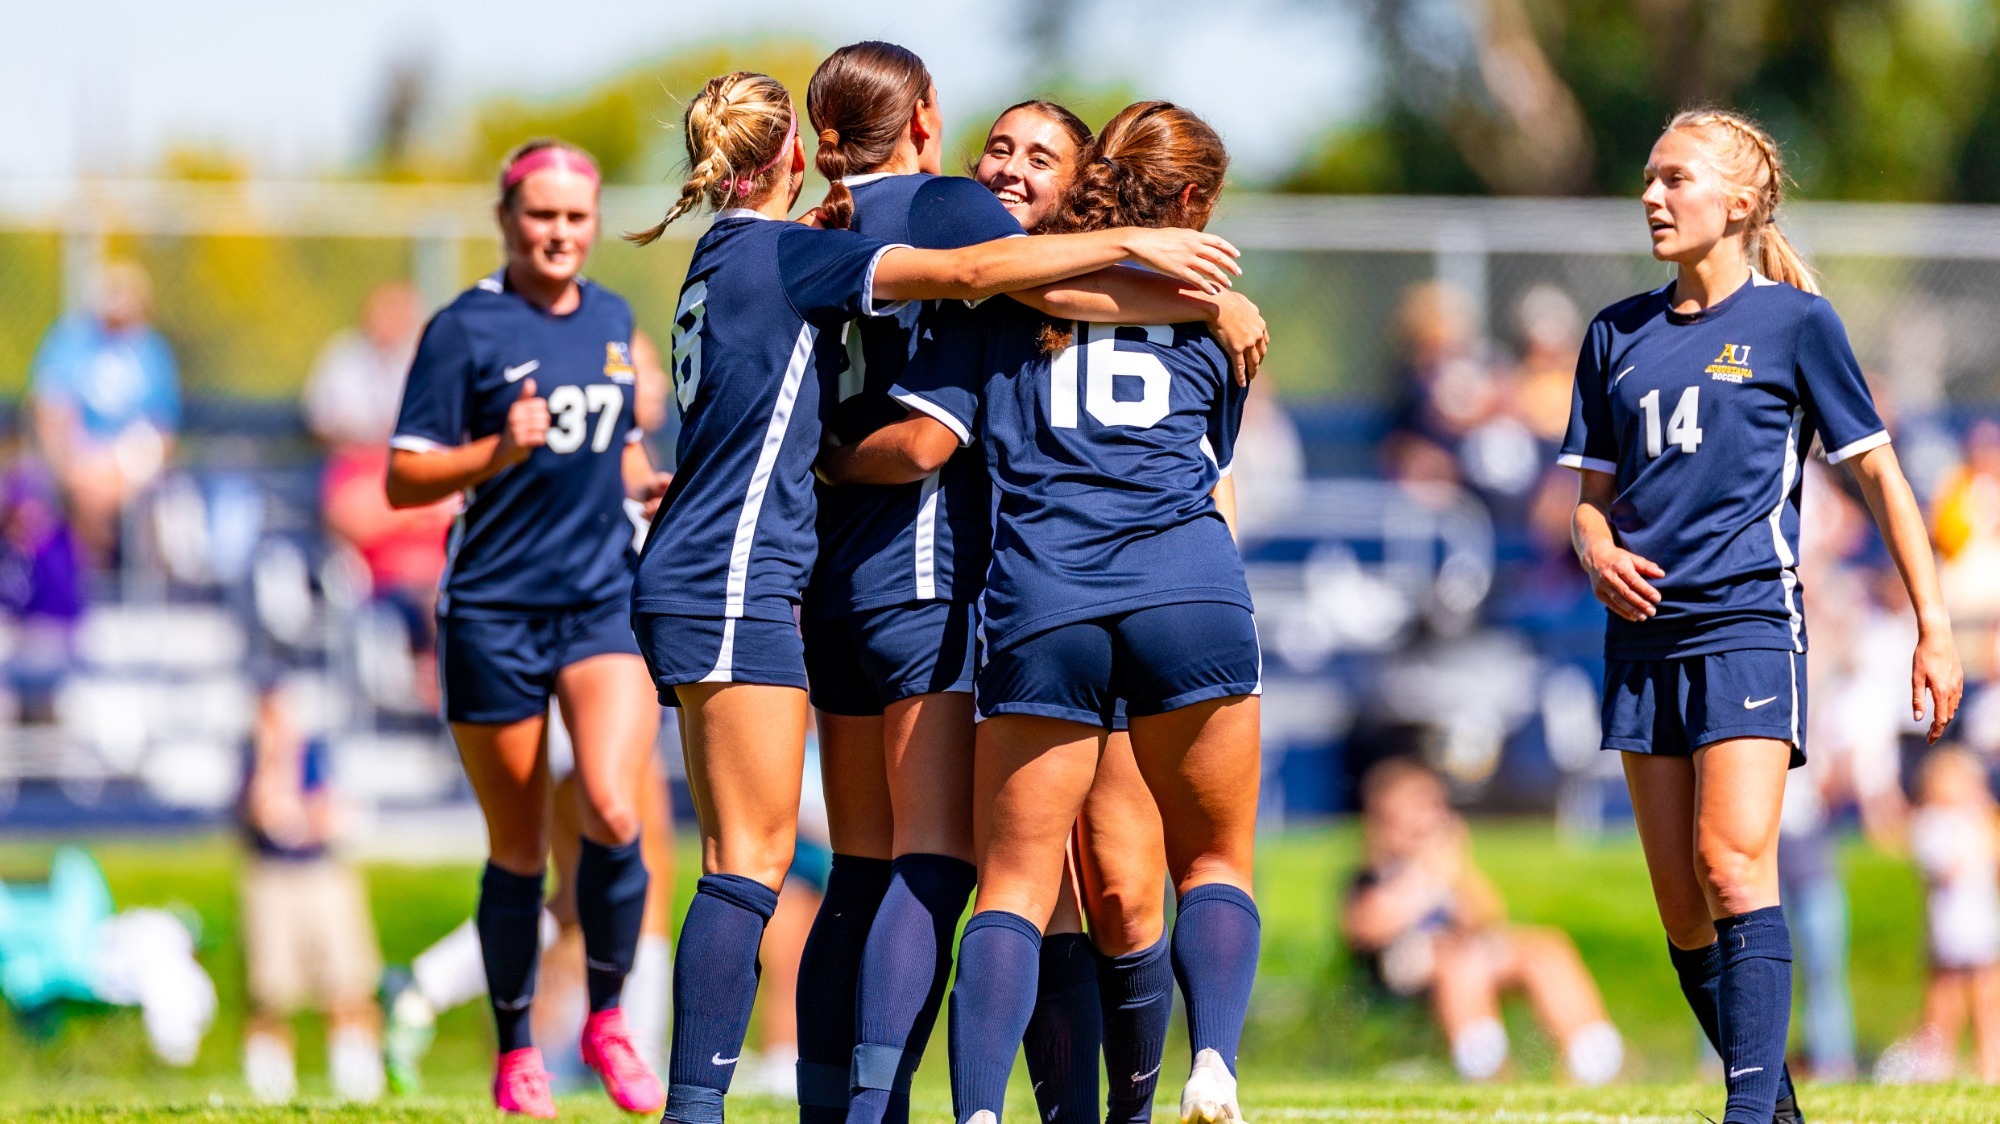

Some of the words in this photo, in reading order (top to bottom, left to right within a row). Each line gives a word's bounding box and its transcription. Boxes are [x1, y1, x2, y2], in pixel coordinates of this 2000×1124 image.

[1050, 321, 1174, 429] 16
[1711, 372, 1743, 384] SOCCER
[1714, 343, 1751, 364] AU
[546, 384, 624, 454] 37
[1639, 385, 1702, 458] 14
